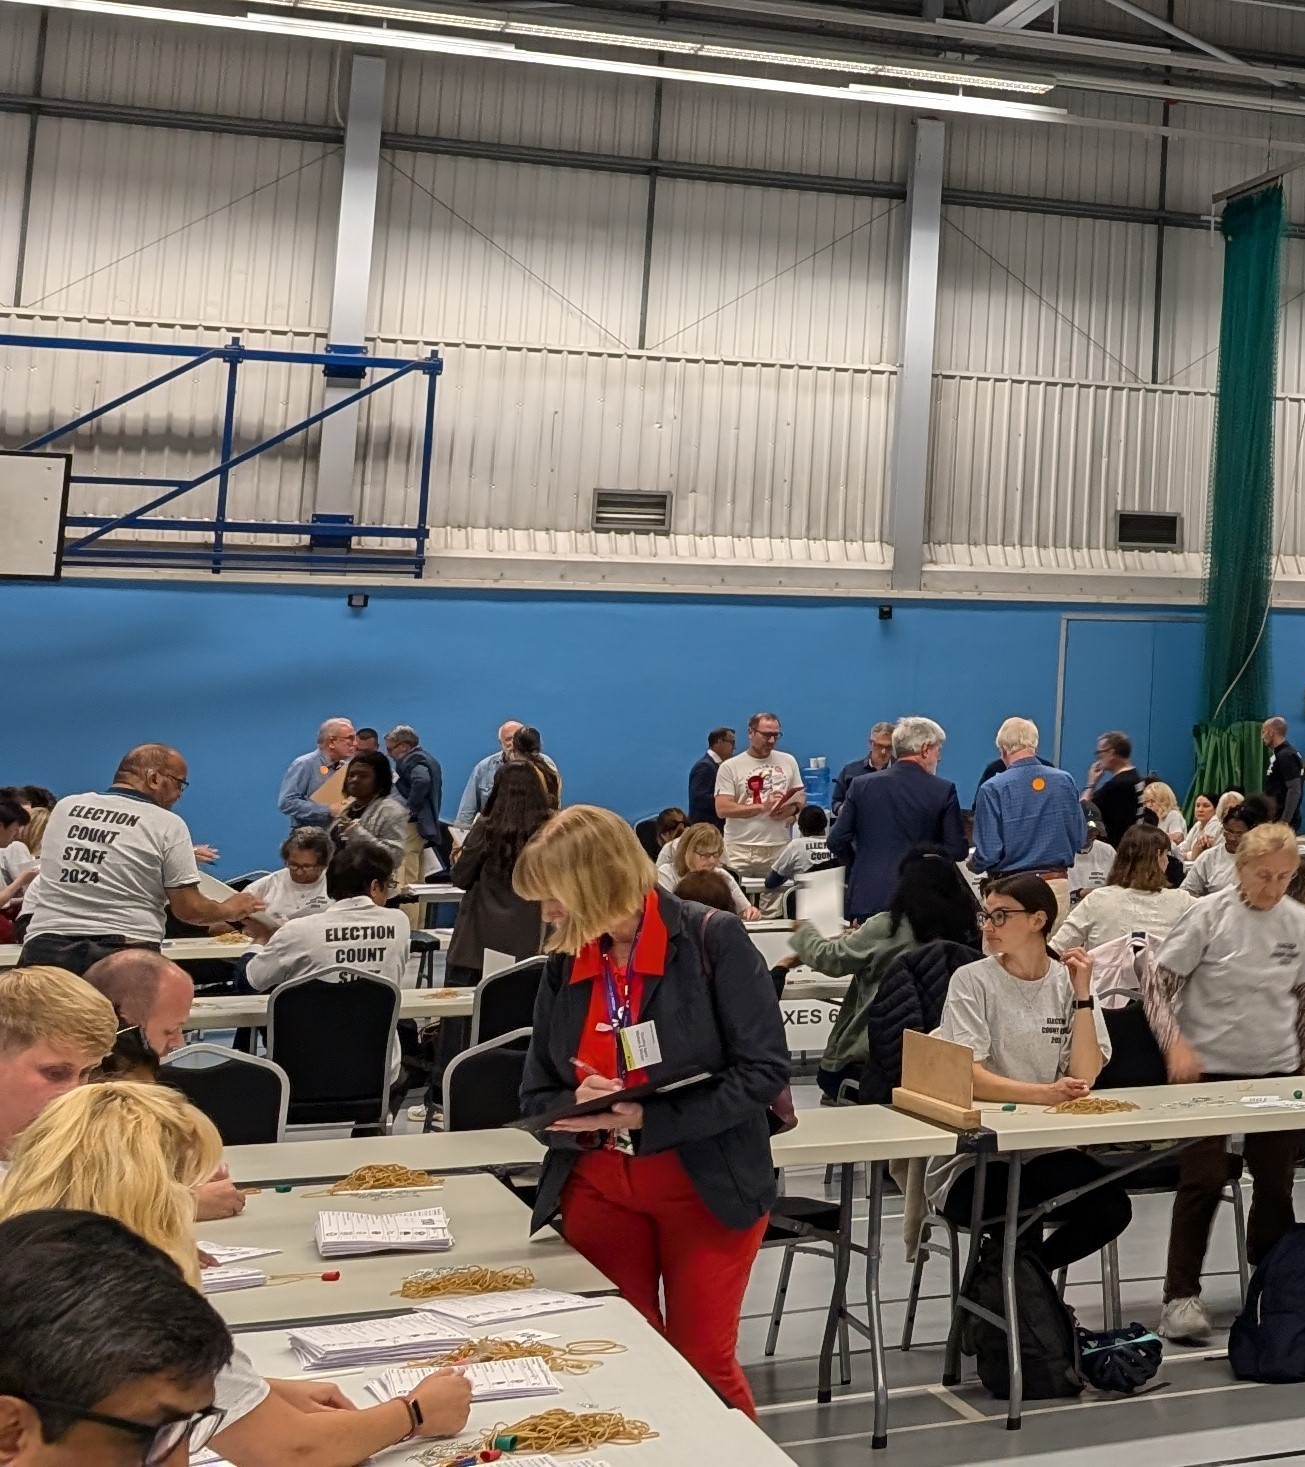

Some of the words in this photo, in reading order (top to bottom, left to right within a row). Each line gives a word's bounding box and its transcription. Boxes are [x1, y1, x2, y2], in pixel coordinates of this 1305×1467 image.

[68, 805, 140, 827] ELECTION
[67, 824, 120, 845] COUNT
[62, 846, 107, 865] STAFF
[59, 868, 100, 884] 2024
[325, 925, 395, 942] ELECTION
[335, 947, 387, 964] COUNT
[783, 1009, 823, 1025] XES
